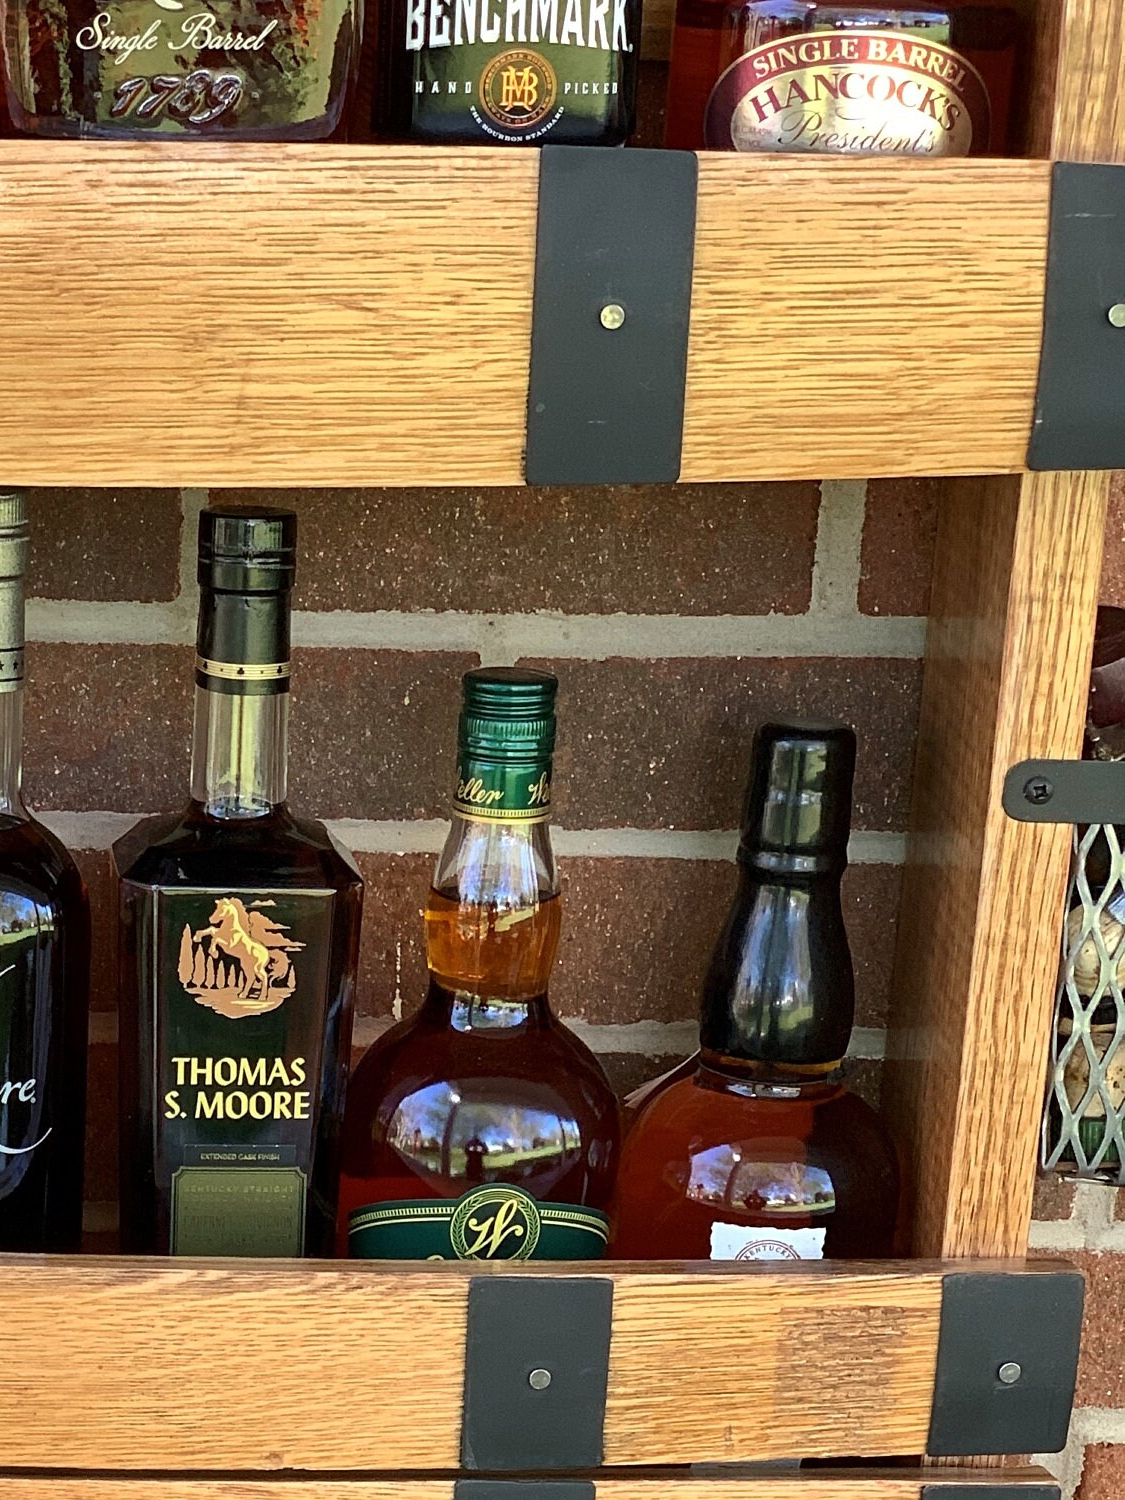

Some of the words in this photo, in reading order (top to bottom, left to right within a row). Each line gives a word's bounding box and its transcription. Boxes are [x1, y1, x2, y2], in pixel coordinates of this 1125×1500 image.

[76, 12, 162, 65] Single
[168, 13, 279, 50] Barrel
[405, 0, 629, 51] BENCHMARK
[753, 38, 858, 79] SINGLE
[867, 39, 967, 92] BARREL
[415, 81, 473, 94] HAND
[564, 81, 618, 95] PICKED
[749, 72, 961, 131] HANCOCK'S
[470, 105, 483, 124] THE
[481, 124, 523, 142] BOURBON
[525, 106, 565, 140] STANDARD
[171, 1057, 306, 1087] THOMAS
[164, 1091, 187, 1120] S.
[195, 1091, 310, 1120] MOORE
[743, 1244, 792, 1260] KENTUCKY
